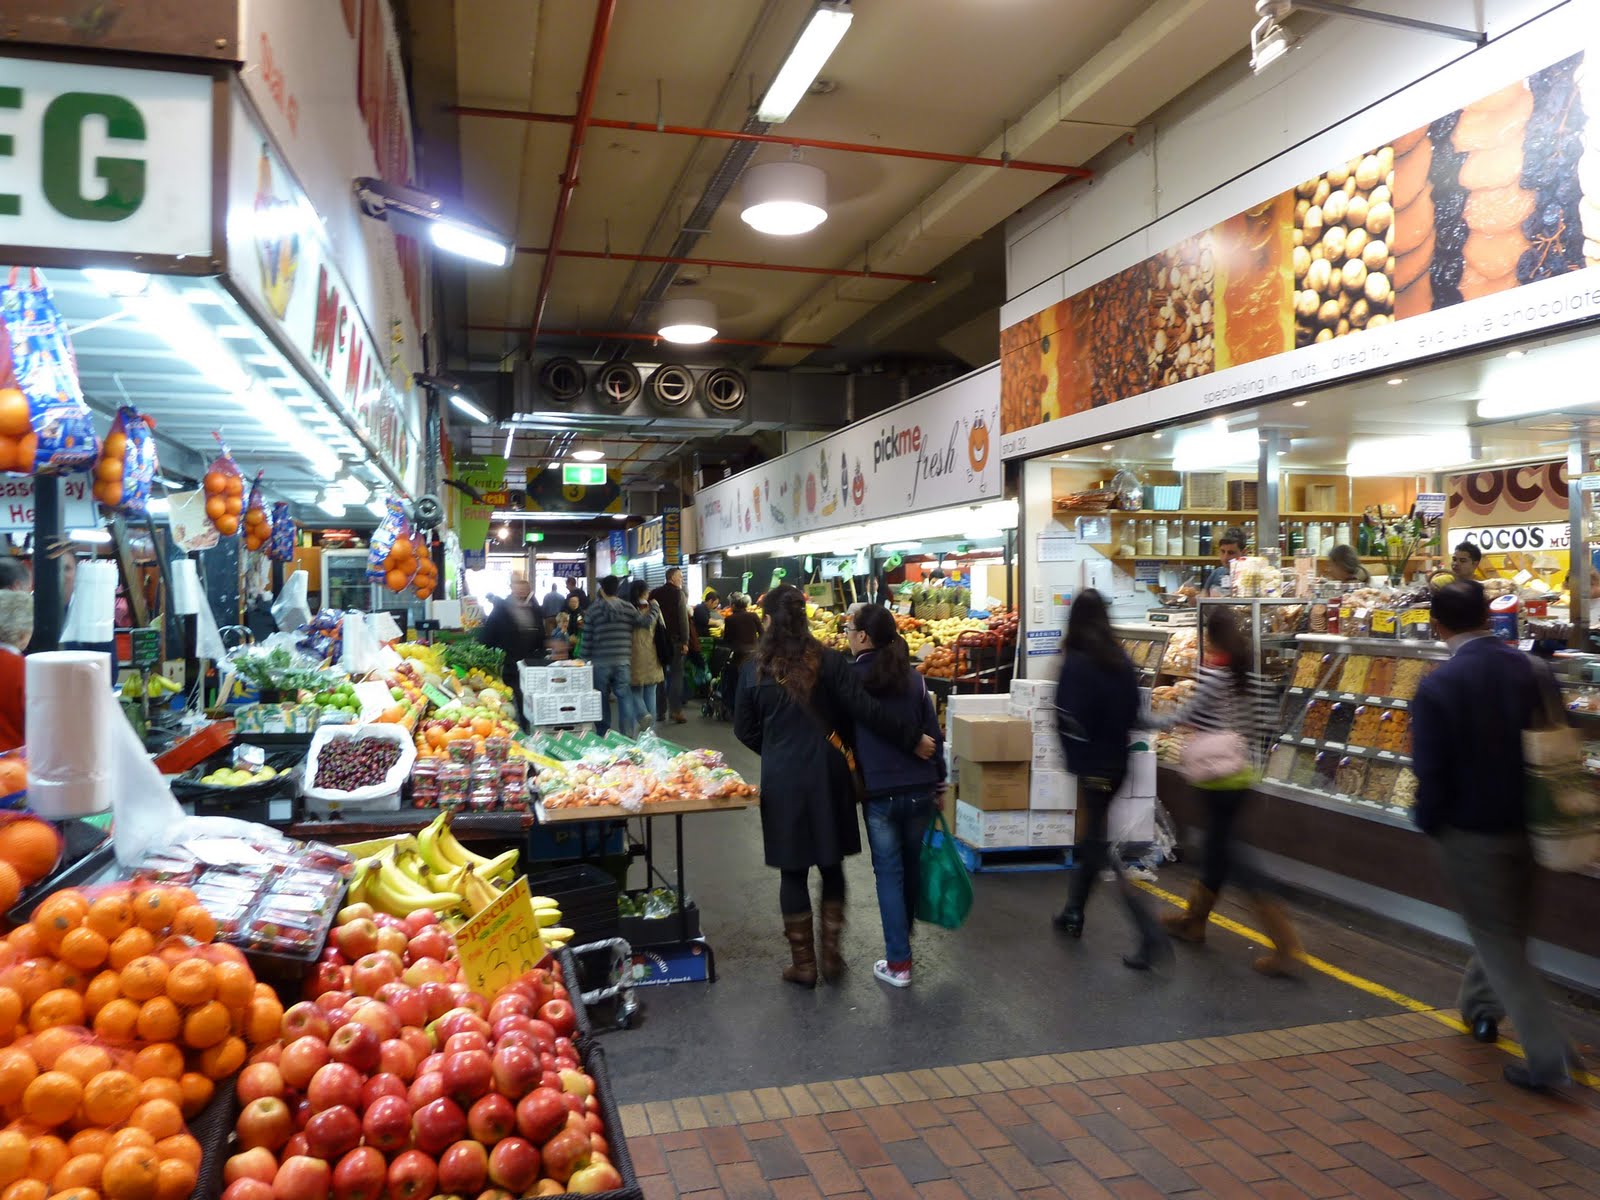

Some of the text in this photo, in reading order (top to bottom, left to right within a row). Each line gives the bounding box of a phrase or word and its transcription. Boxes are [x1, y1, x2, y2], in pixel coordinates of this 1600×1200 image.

[0, 87, 147, 222] G
[1203, 378, 1264, 404] specialising
[874, 425, 921, 473] pickme
[906, 420, 960, 507] fresh
[1465, 526, 1544, 550] COCO'S
